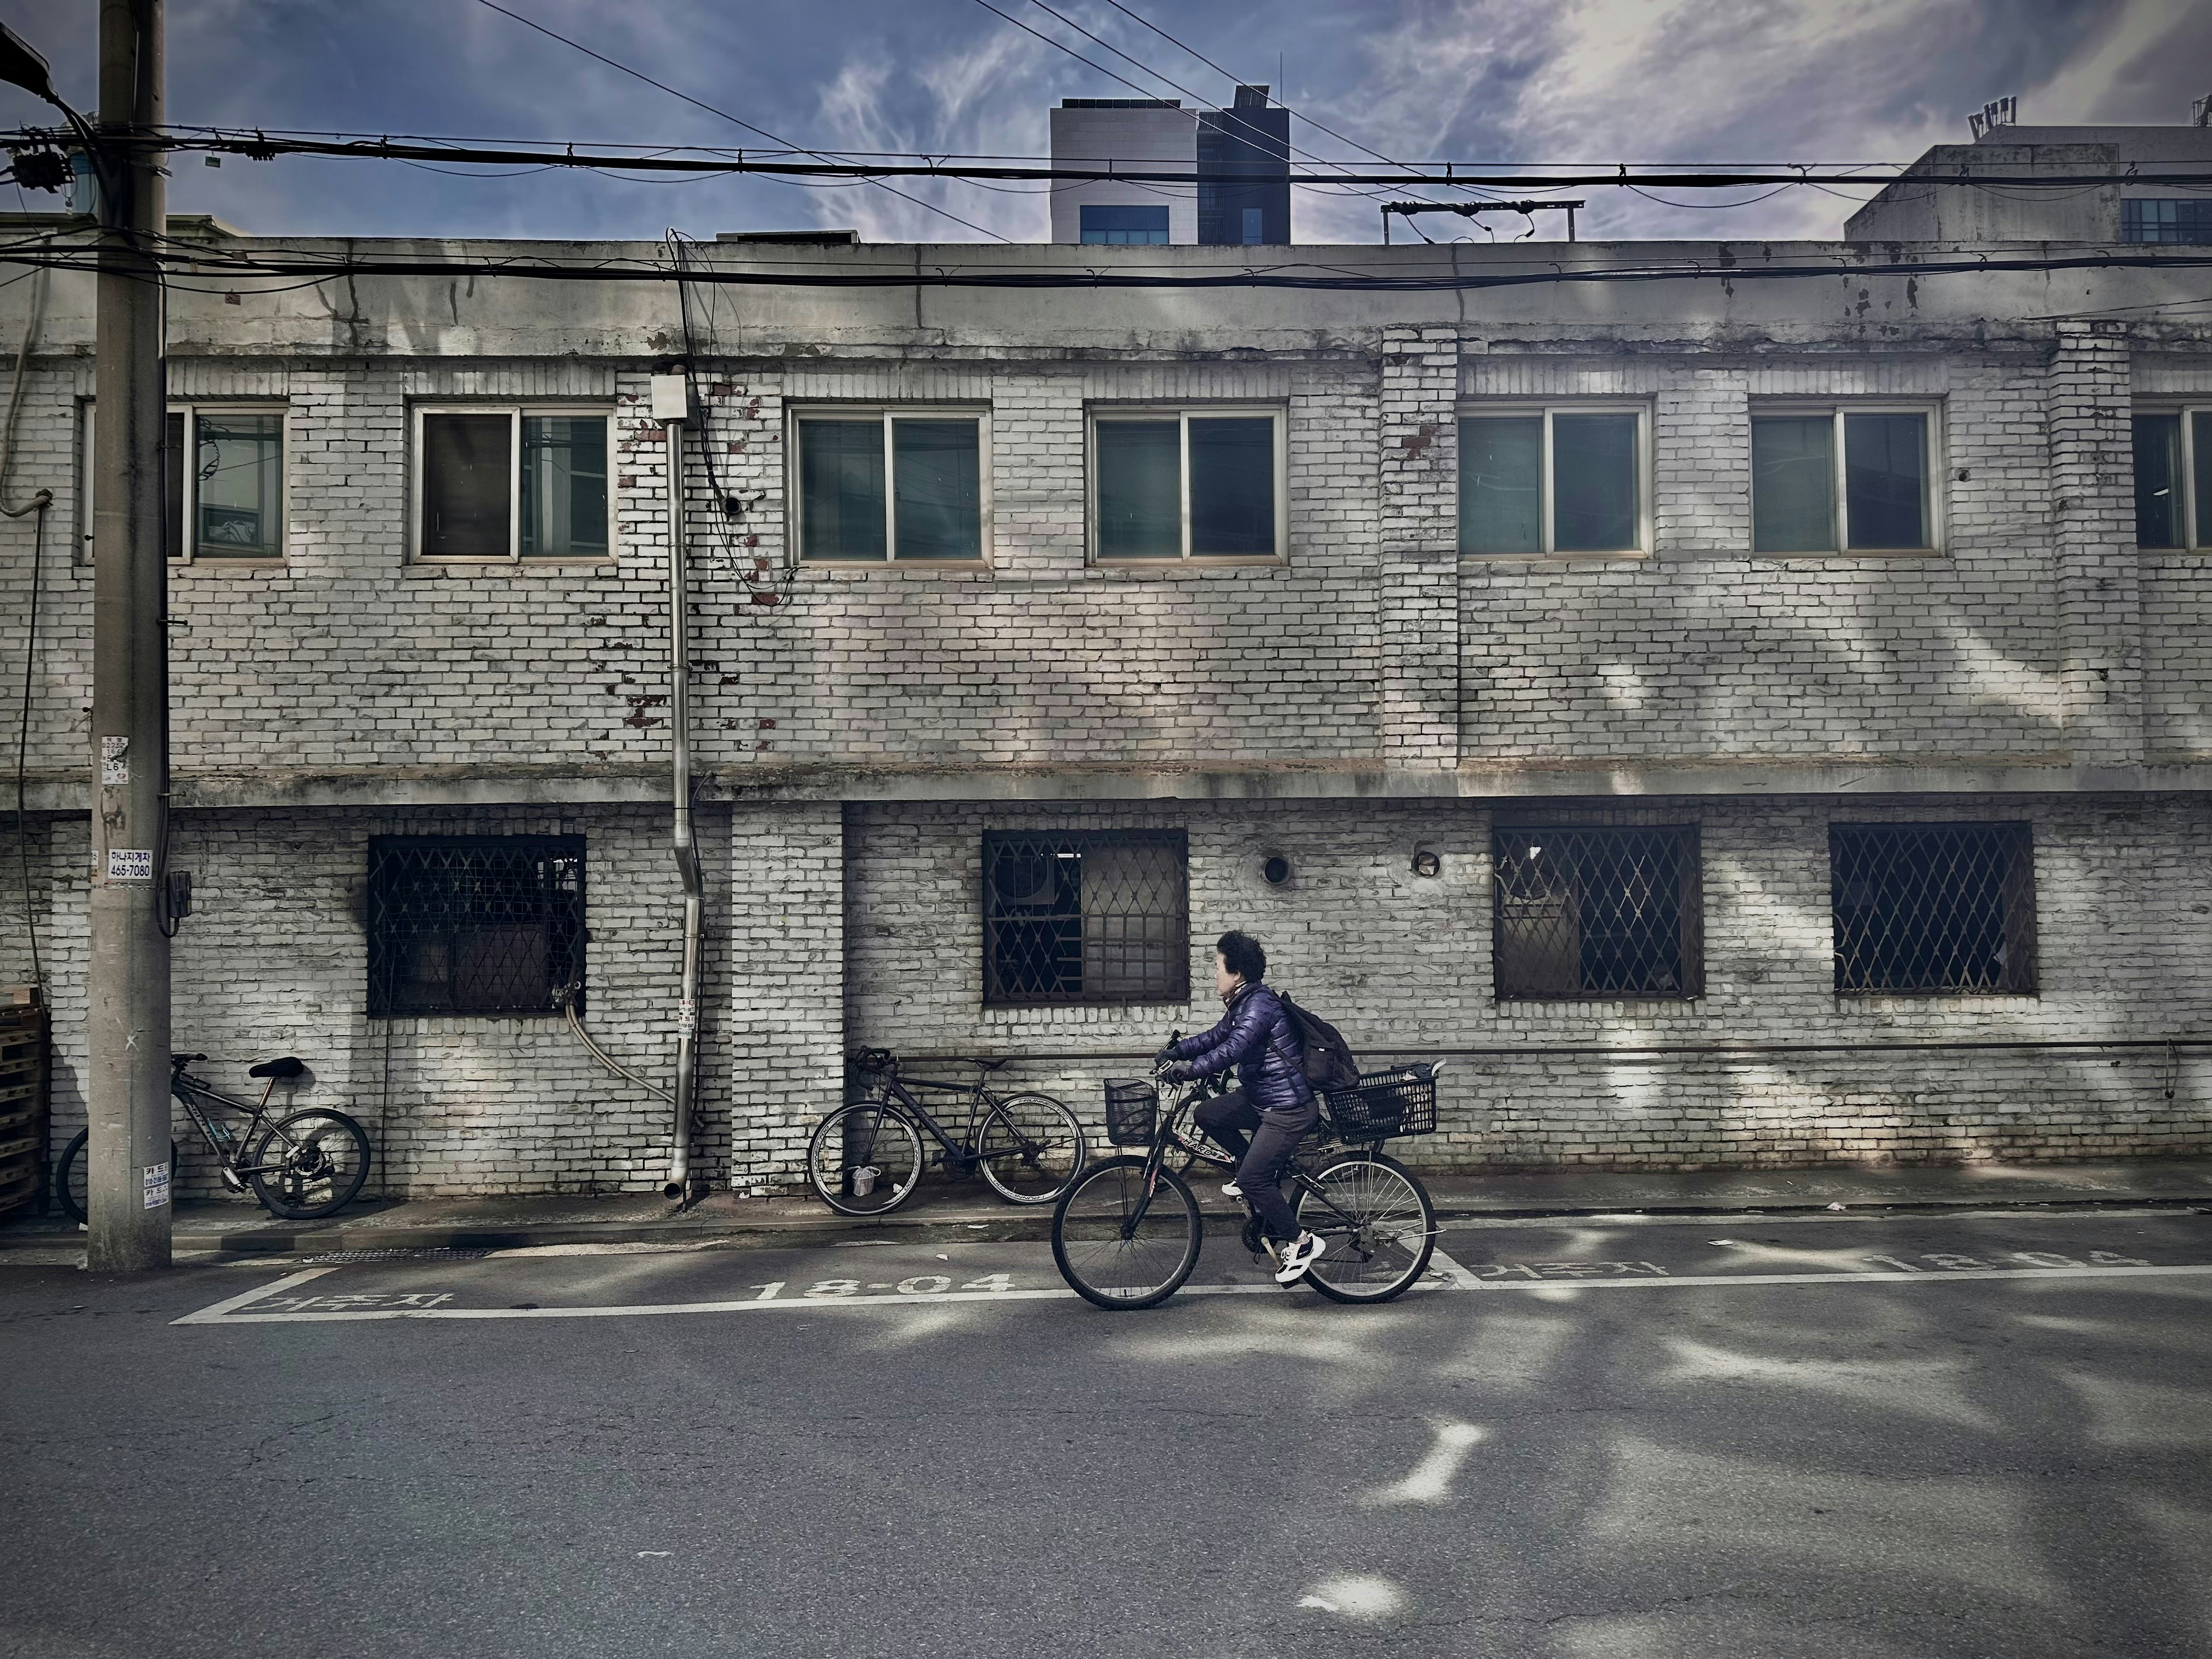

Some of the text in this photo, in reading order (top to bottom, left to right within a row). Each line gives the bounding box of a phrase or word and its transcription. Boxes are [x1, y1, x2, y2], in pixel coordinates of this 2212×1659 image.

[111, 851, 150, 862] 하나지게차
[111, 864, 150, 877] 465-7080
[1861, 1250, 2154, 1271] 18-04
[1469, 1261, 1670, 1279] 거주자
[749, 1273, 1015, 1300] 18-04
[241, 1293, 454, 1312] 거주자
